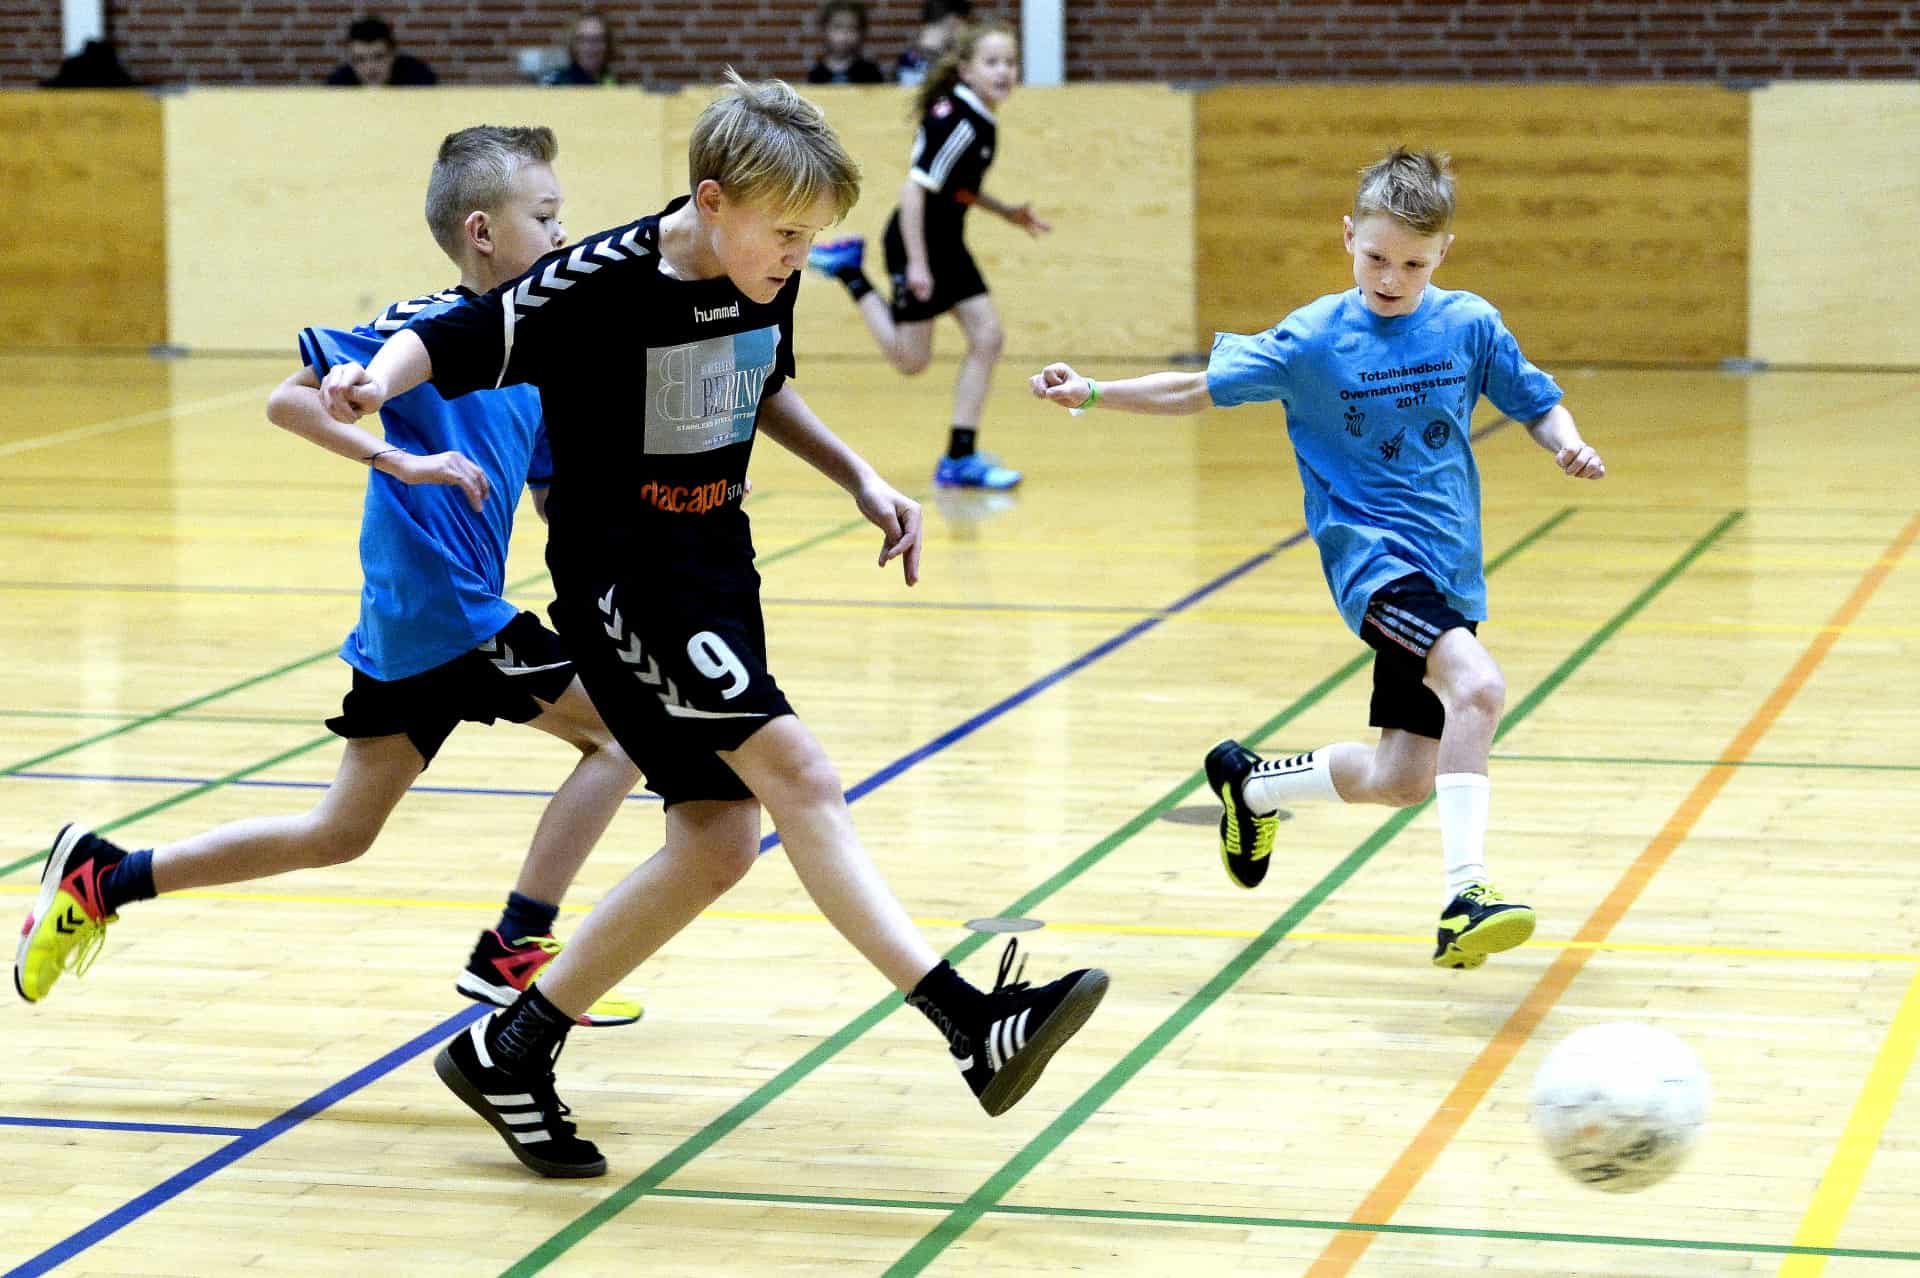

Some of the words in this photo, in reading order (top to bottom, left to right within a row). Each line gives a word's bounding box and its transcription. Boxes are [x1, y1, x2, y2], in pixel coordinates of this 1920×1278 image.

[694, 302, 740, 323] hummel
[1358, 360, 1453, 383] Totalhåndbold
[1396, 393, 1427, 409] 2017
[641, 478, 727, 515] dacapo
[687, 630, 750, 700] 9
